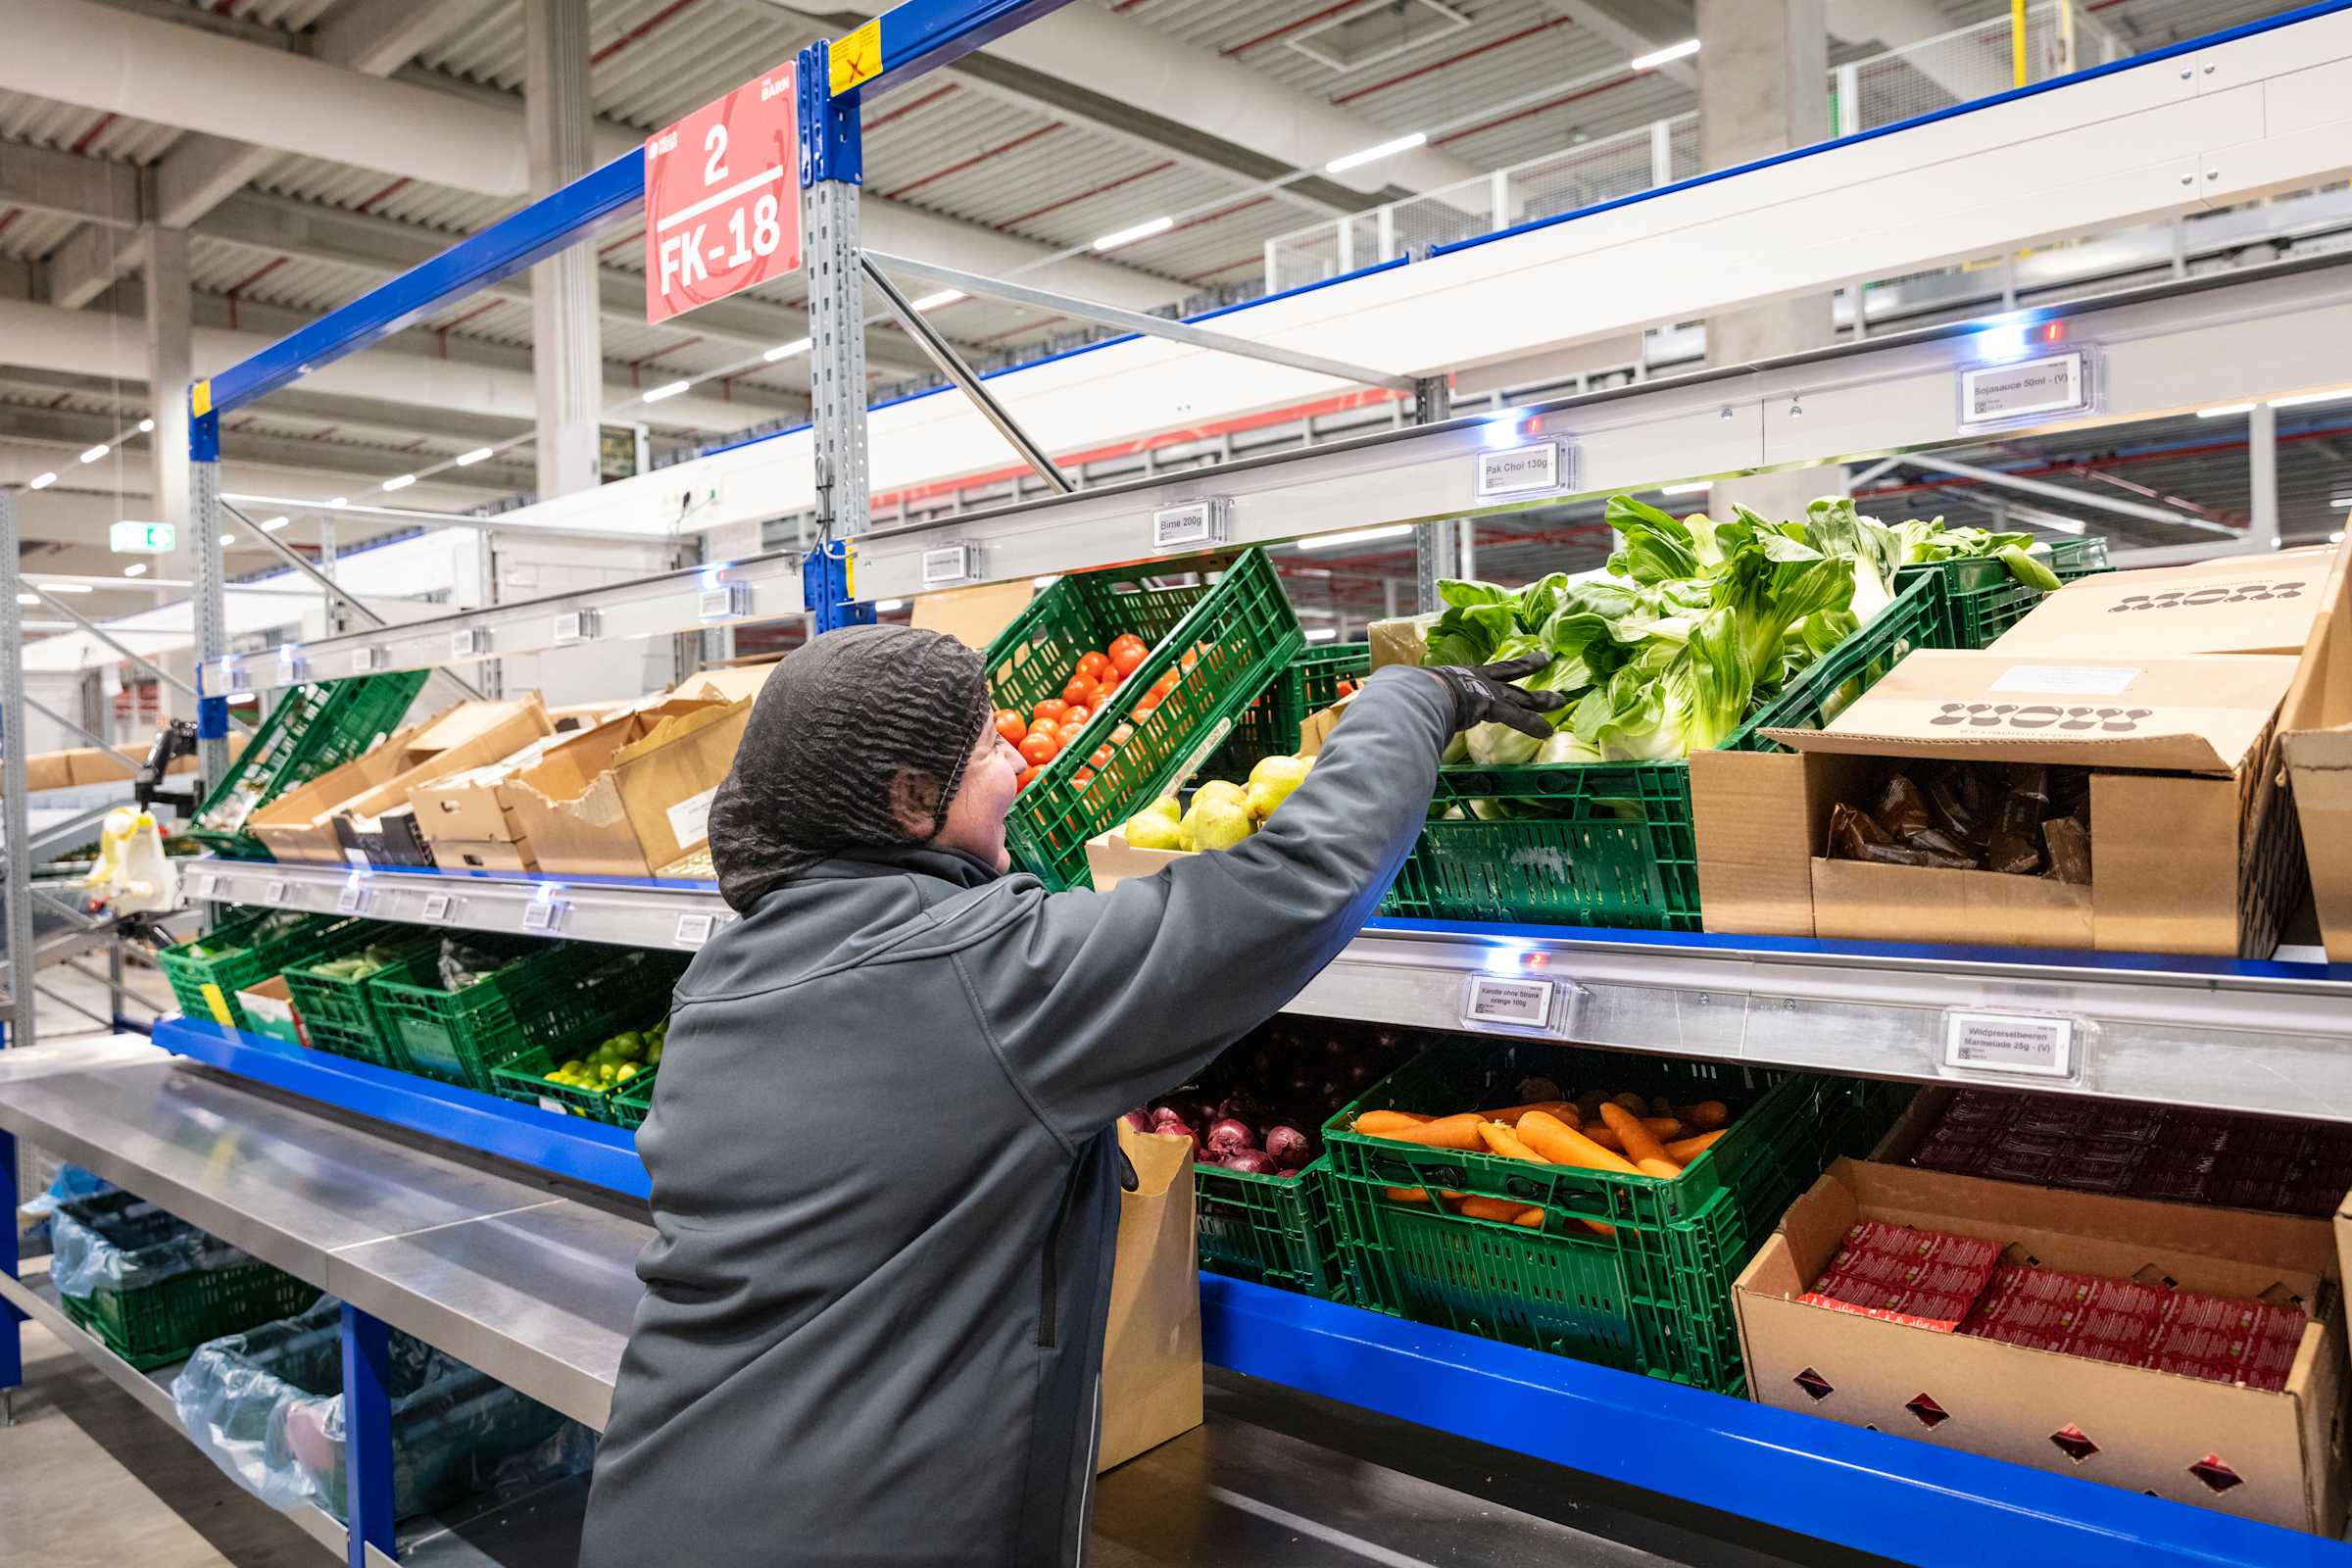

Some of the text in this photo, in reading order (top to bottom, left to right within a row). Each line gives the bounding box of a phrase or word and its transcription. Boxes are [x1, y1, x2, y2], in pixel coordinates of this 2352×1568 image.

[705, 123, 729, 186] 2
[660, 194, 780, 296] FK-18
[1975, 381, 2022, 396] Sojasauce
[2024, 377, 2046, 388] 50ml
[2054, 372, 2068, 385] (V)
[1486, 459, 1548, 475] Pak Choi 130g
[1160, 515, 1201, 530] Birne 200g
[1964, 1038, 2011, 1050] Marmelade
[2014, 1042, 2030, 1052] 25g
[2037, 1042, 2051, 1054] (V)
